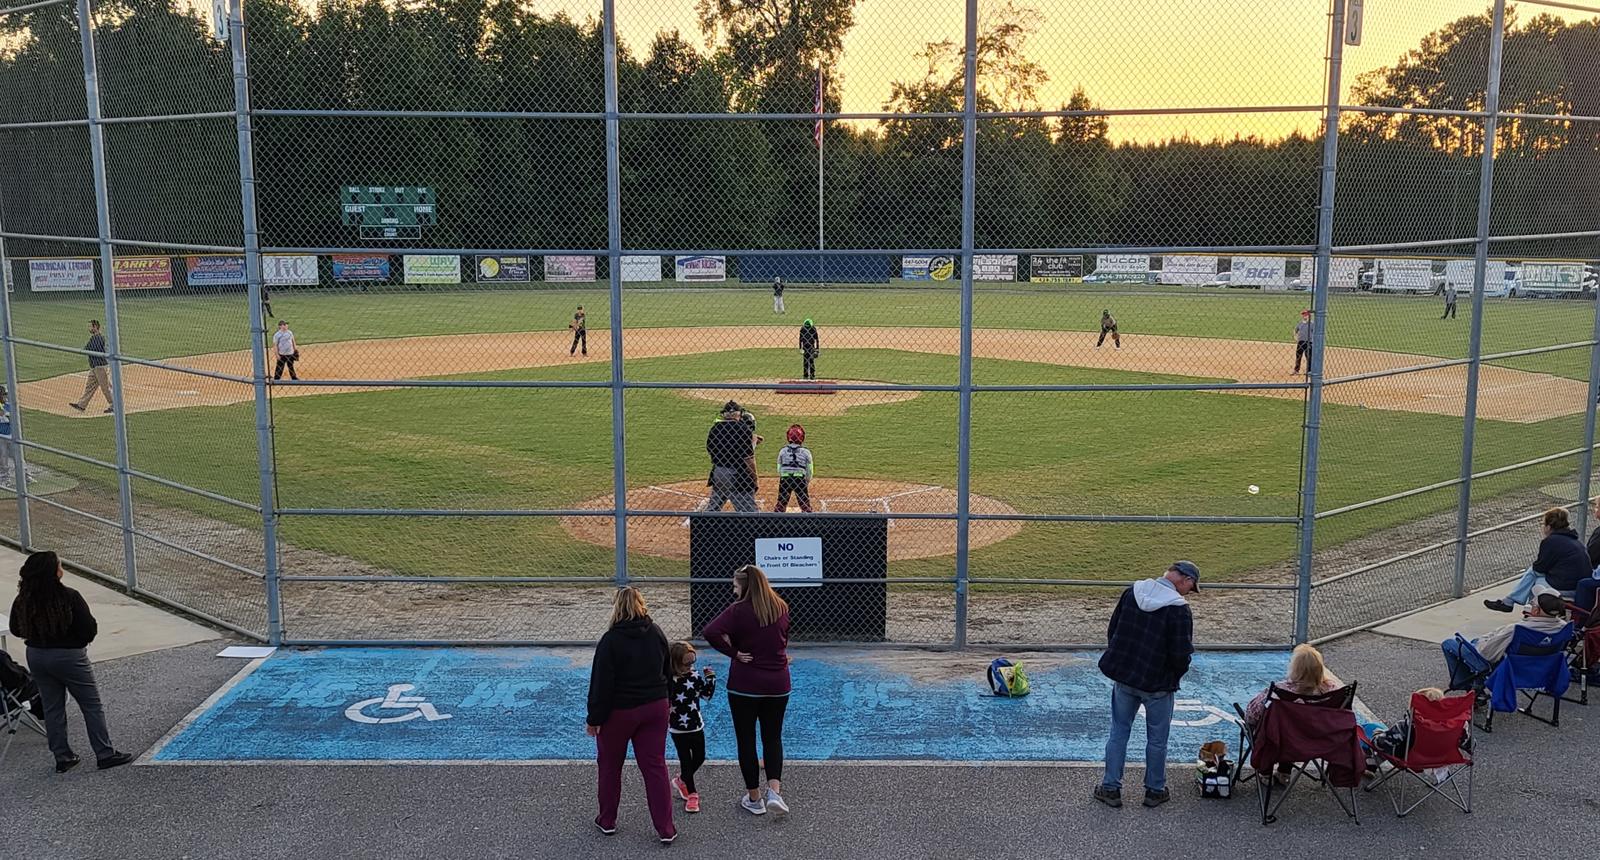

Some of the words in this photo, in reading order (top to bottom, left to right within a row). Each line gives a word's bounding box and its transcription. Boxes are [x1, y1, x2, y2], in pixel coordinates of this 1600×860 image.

[217, 4, 224, 36] 3
[1350, 10, 1359, 41] 3
[31, 262, 67, 271] AMERICAN
[1246, 268, 1280, 279] BGF
[778, 543, 794, 551] NO
